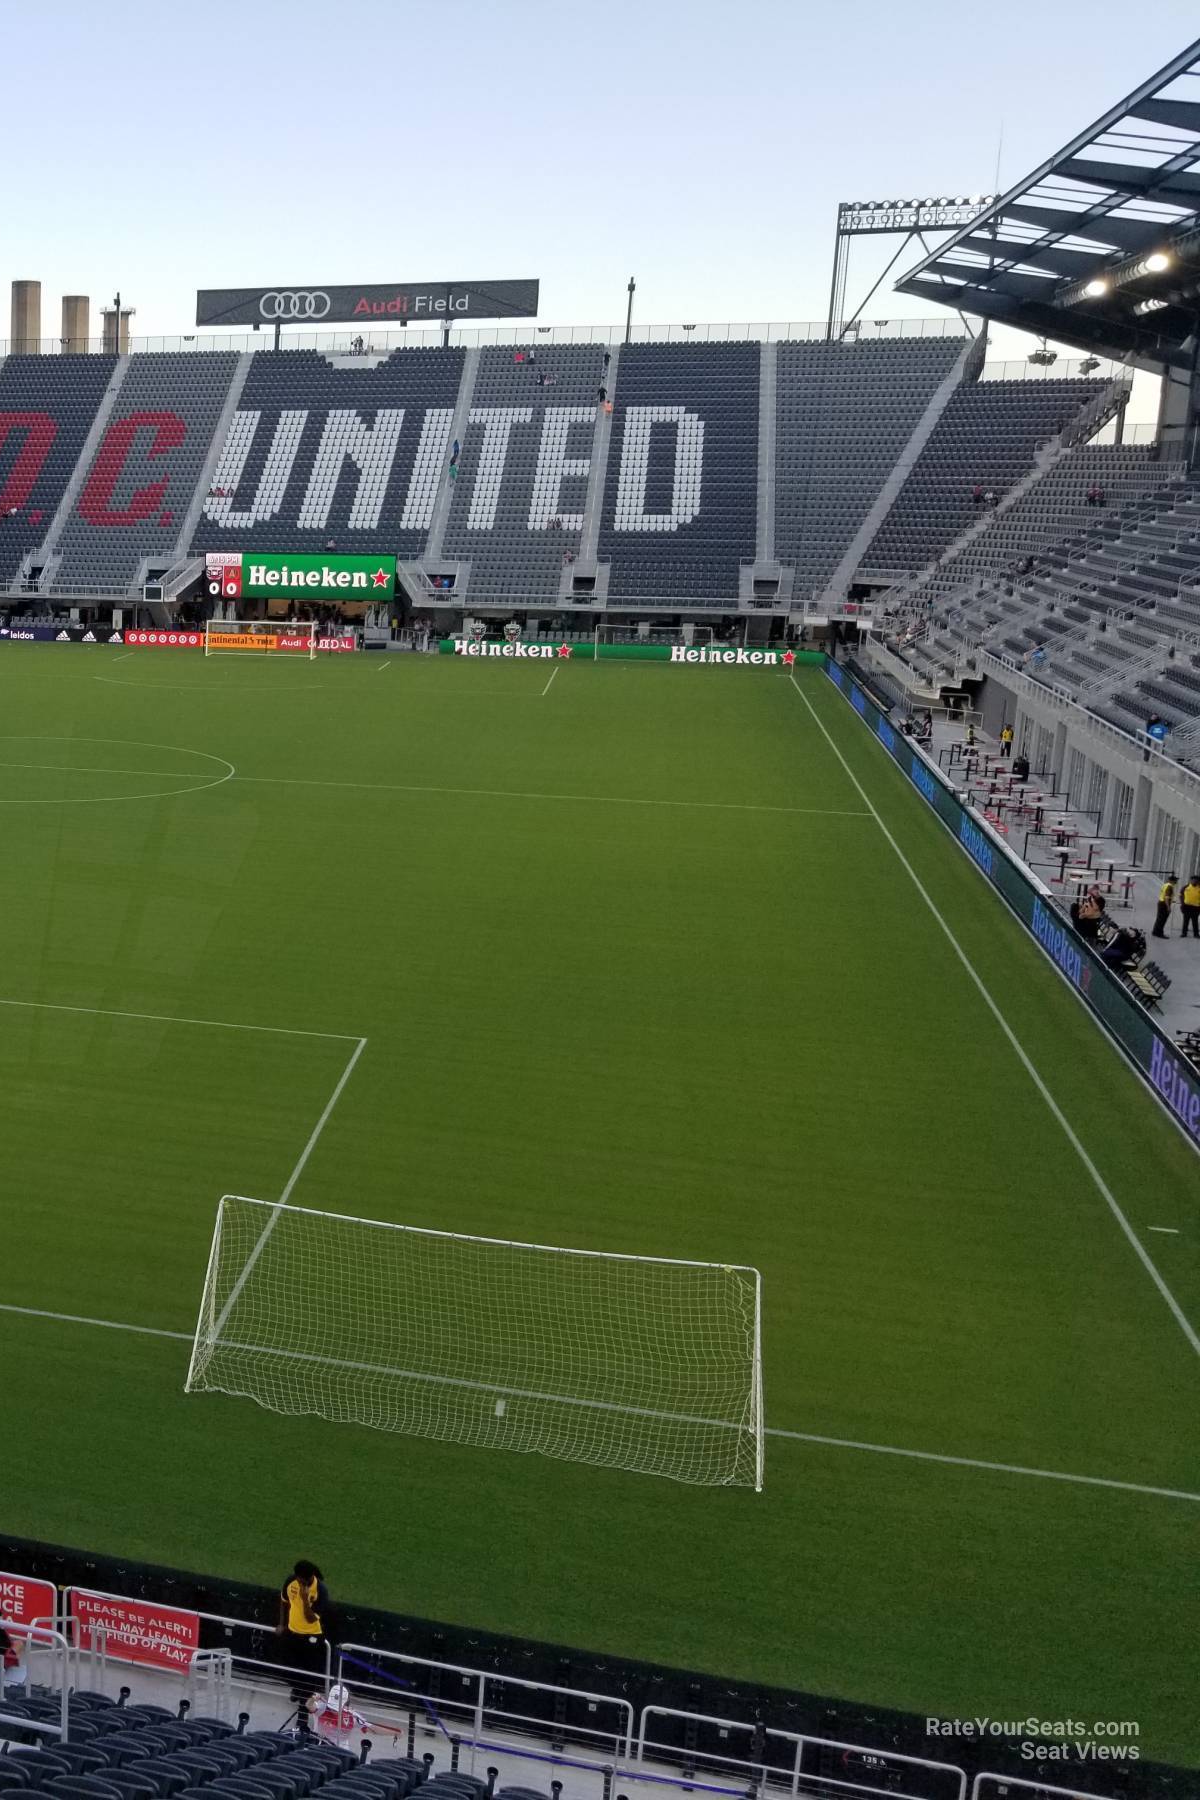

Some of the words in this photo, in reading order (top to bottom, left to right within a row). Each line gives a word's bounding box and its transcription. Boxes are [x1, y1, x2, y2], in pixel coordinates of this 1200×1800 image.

[353, 294, 408, 315] Audi
[414, 294, 469, 313] Field
[203, 406, 705, 531] UNITED
[248, 565, 368, 588] Heineken
[209, 582, 219, 595] 0
[226, 582, 237, 595] 0
[281, 639, 302, 647] Audi
[454, 639, 554, 658] Heineken
[670, 645, 778, 665] Heineken
[1031, 896, 1082, 987] Heineken
[78, 1600, 126, 1619] PLEASE
[128, 1613, 145, 1624] BE
[149, 1618, 192, 1639] ALERT!
[88, 1616, 118, 1630] BALL
[120, 1622, 145, 1636] MAY
[106, 1630, 138, 1646] FIELD
[141, 1639, 158, 1650] OF
[160, 1644, 188, 1664] PLAY.
[862, 1755, 878, 1764] 135
